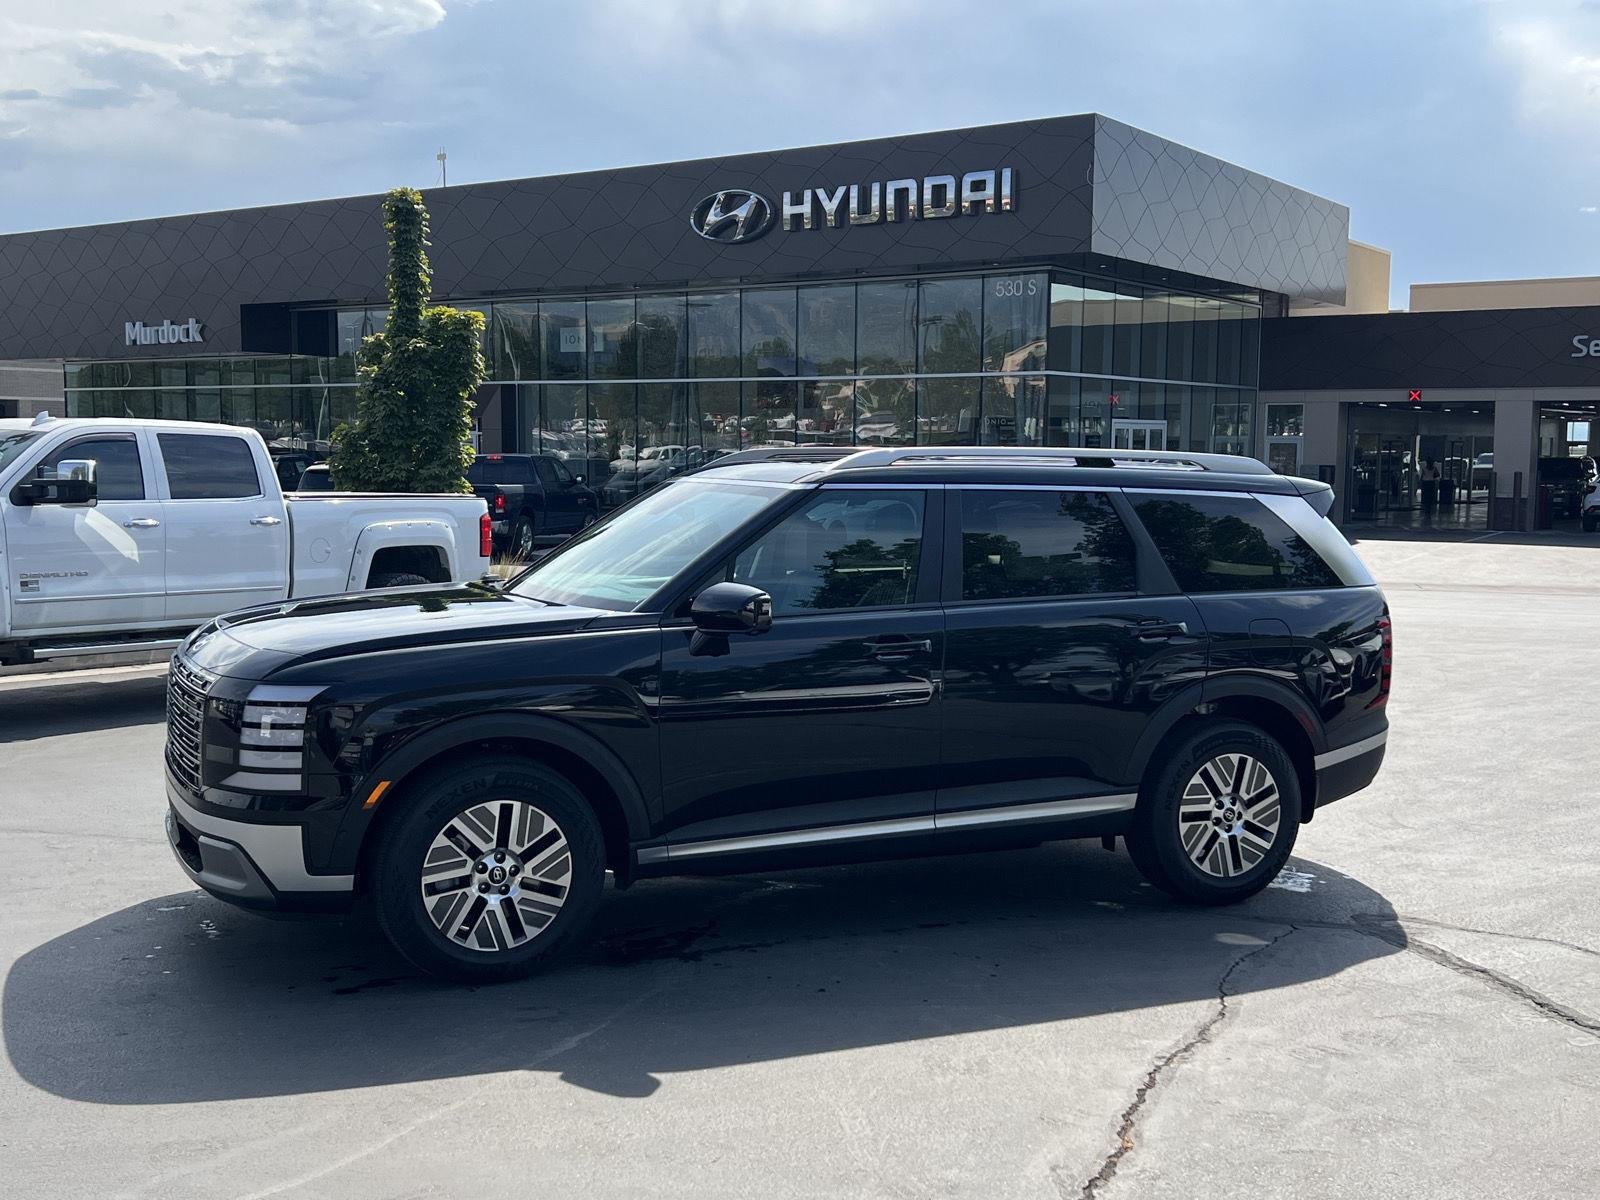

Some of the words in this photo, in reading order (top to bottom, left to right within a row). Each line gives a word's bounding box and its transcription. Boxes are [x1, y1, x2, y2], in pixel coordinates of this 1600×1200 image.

[782, 167, 1015, 231] HYUNDAI
[995, 280, 1023, 297] 530
[1027, 279, 1037, 296] S
[125, 318, 203, 346] Murdock
[1571, 335, 1600, 357] Se
